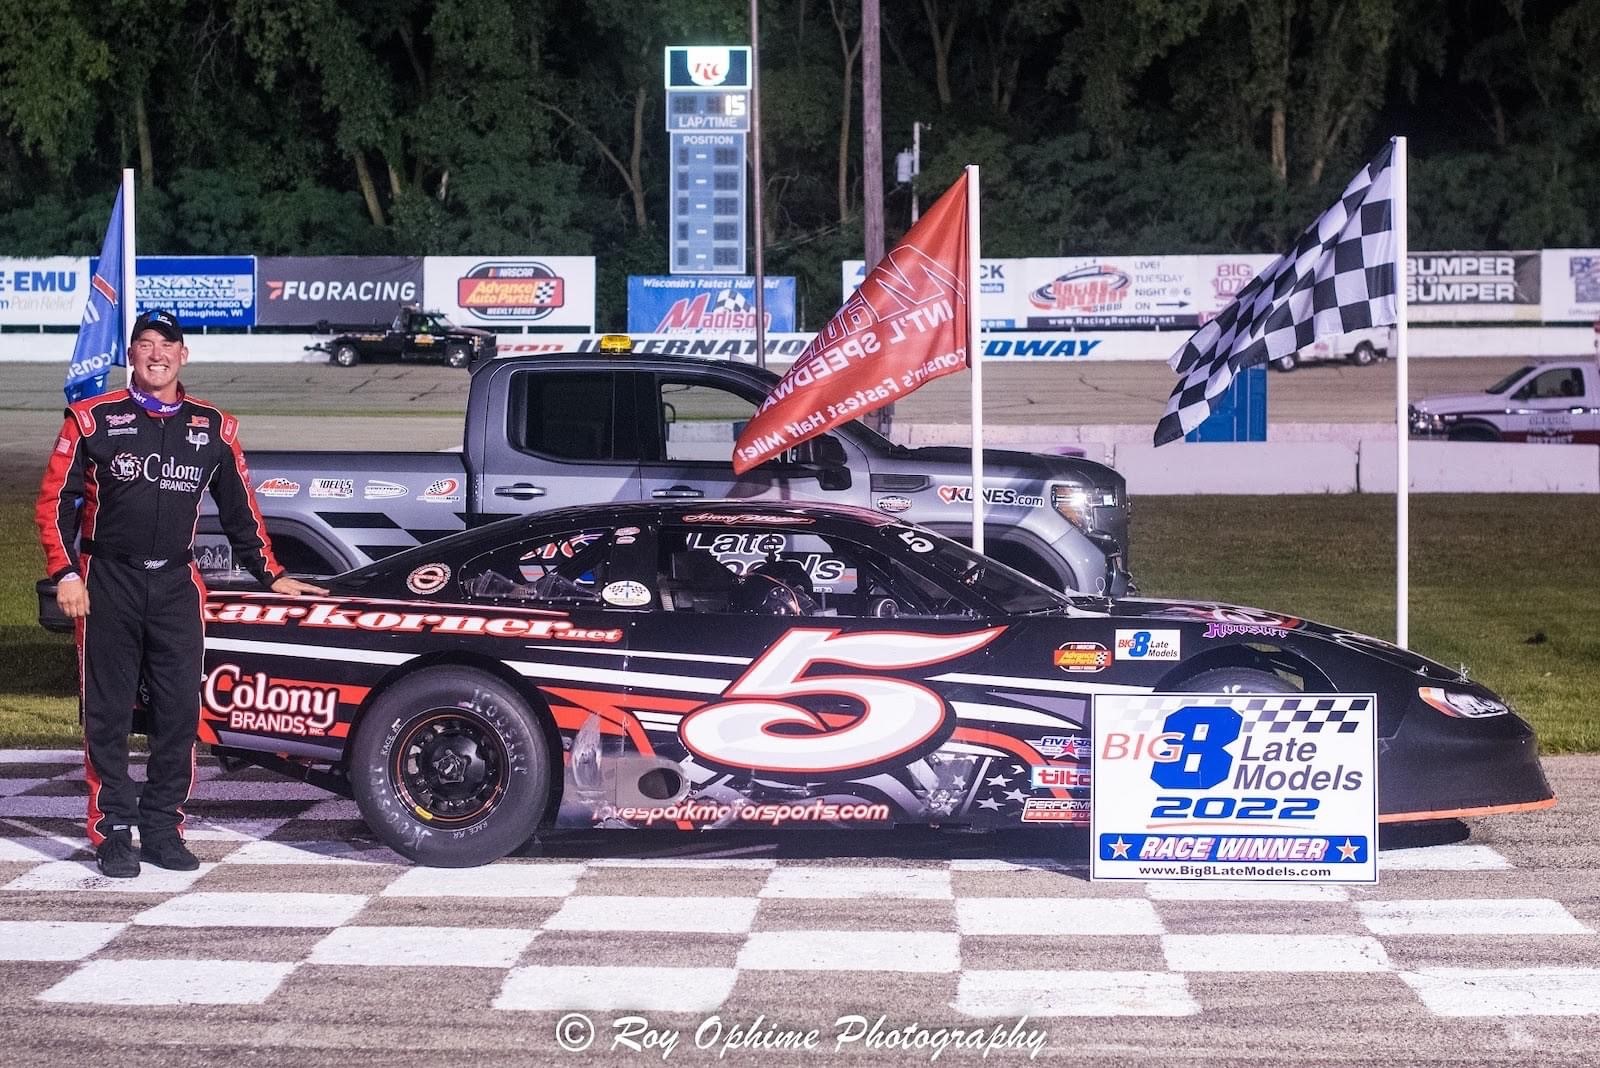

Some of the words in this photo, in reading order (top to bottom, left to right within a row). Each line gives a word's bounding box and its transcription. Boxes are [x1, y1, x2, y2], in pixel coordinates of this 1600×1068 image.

[725, 94, 746, 116] 15
[678, 116, 738, 129] LAP/TIME
[683, 135, 734, 145] POSITION
[1135, 275, 1184, 283] TUESDAY
[1217, 264, 1252, 277] BIG
[283, 281, 416, 301] FLORACING
[477, 281, 533, 293] Advance
[643, 279, 696, 289] Wisconsin's
[698, 280, 733, 289] Fastest
[1135, 288, 1166, 296] NIGHT
[1135, 302, 1150, 310] ON
[144, 453, 203, 489] Colony
[160, 479, 191, 492] BRANDS
[899, 530, 935, 553] 5
[1118, 639, 1135, 648] BIG
[1128, 632, 1151, 657] 8
[1150, 640, 1169, 649] Late
[1148, 649, 1178, 658] Models
[206, 664, 337, 728] Colony
[678, 625, 1008, 773] 5
[230, 711, 307, 735] BRANDS,
[1101, 732, 1185, 763] BIG
[1150, 706, 1243, 790] 8
[1241, 736, 1317, 762] Late
[1233, 764, 1363, 791] Models
[1150, 796, 1321, 820] 2022
[1138, 836, 1215, 861] RACE
[1216, 838, 1329, 862] WINNER
[1139, 865, 1331, 878] www.Big8LateModels.com
